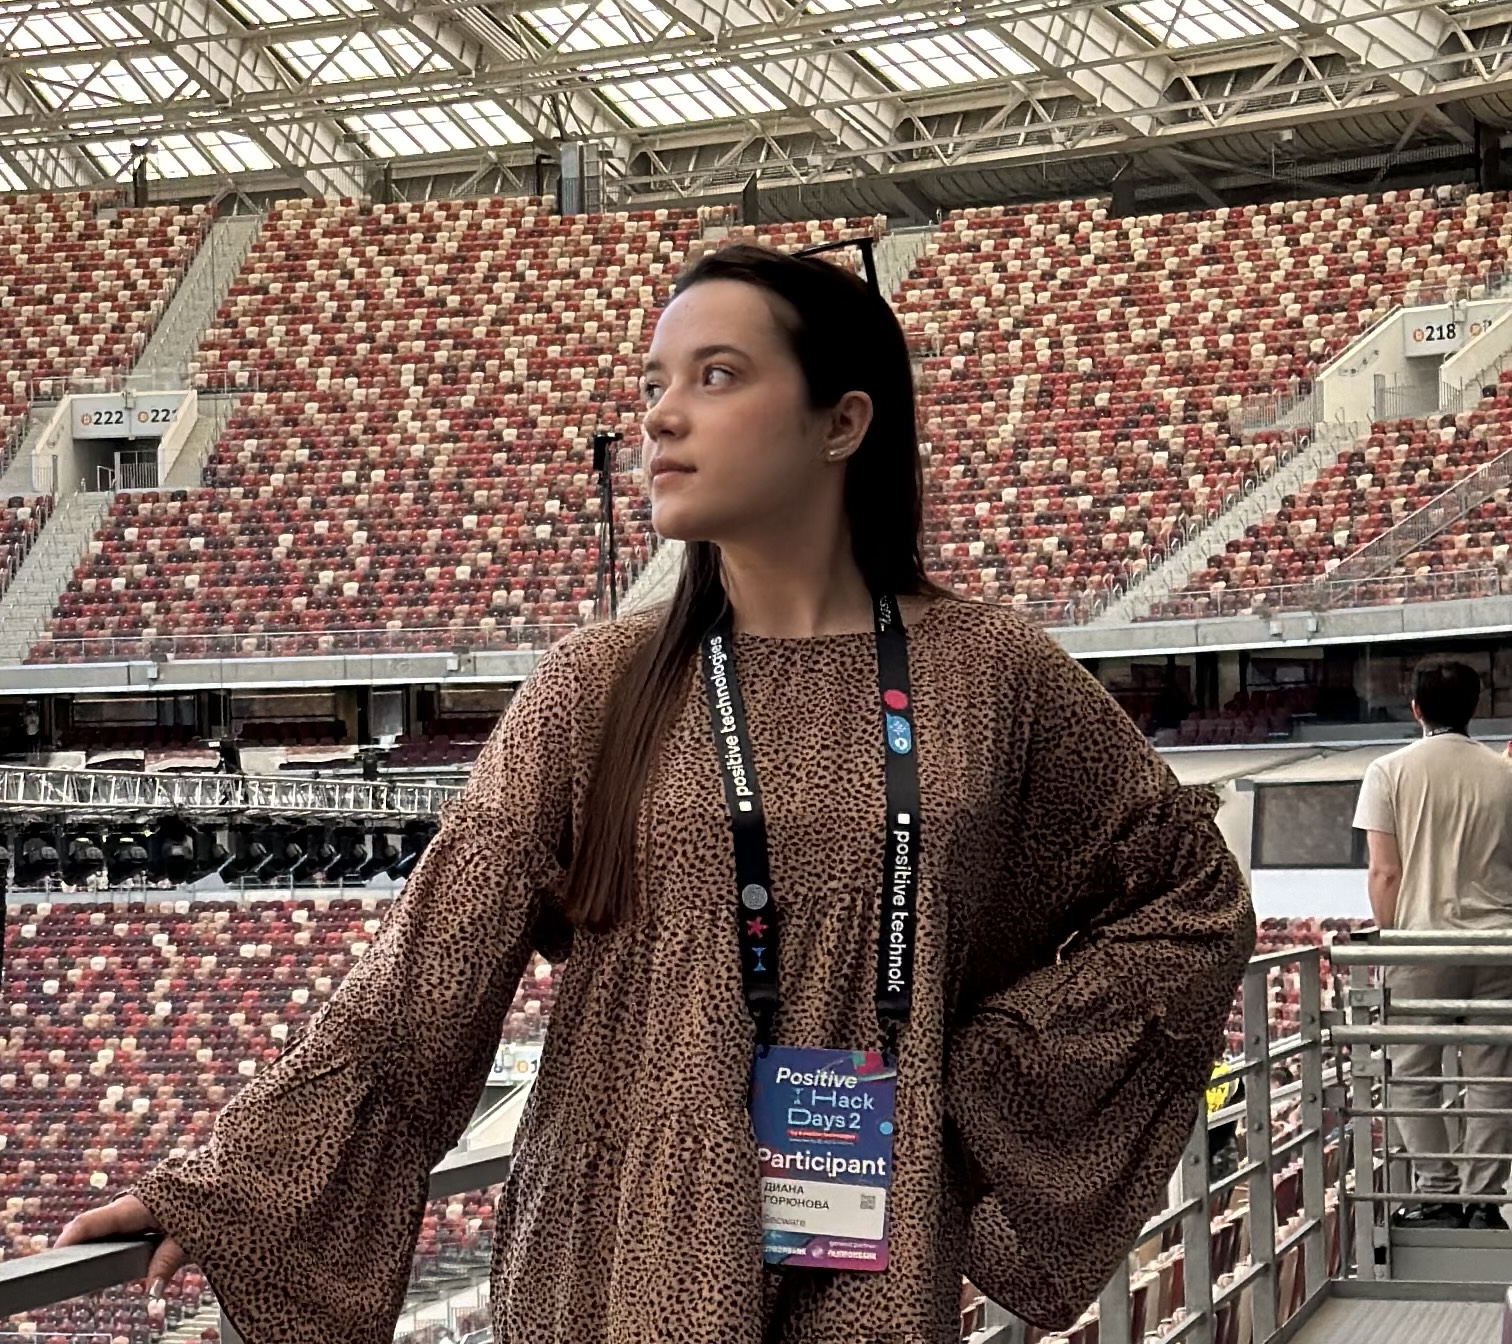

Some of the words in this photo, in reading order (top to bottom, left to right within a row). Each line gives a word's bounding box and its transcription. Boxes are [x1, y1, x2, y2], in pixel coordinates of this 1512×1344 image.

[1425, 323, 1456, 342] 218
[93, 410, 124, 426] 222
[710, 635, 734, 733] technologies
[724, 734, 755, 797] positive
[892, 830, 912, 907] positive
[775, 1066, 859, 1090] Positive
[811, 1088, 875, 1112] Hack
[787, 1107, 846, 1132] Days
[849, 1112, 862, 1130] 2
[758, 1147, 887, 1178] Participant
[764, 1181, 805, 1194] ДИАНА
[762, 1194, 830, 1210] ГОРЮНОВА
